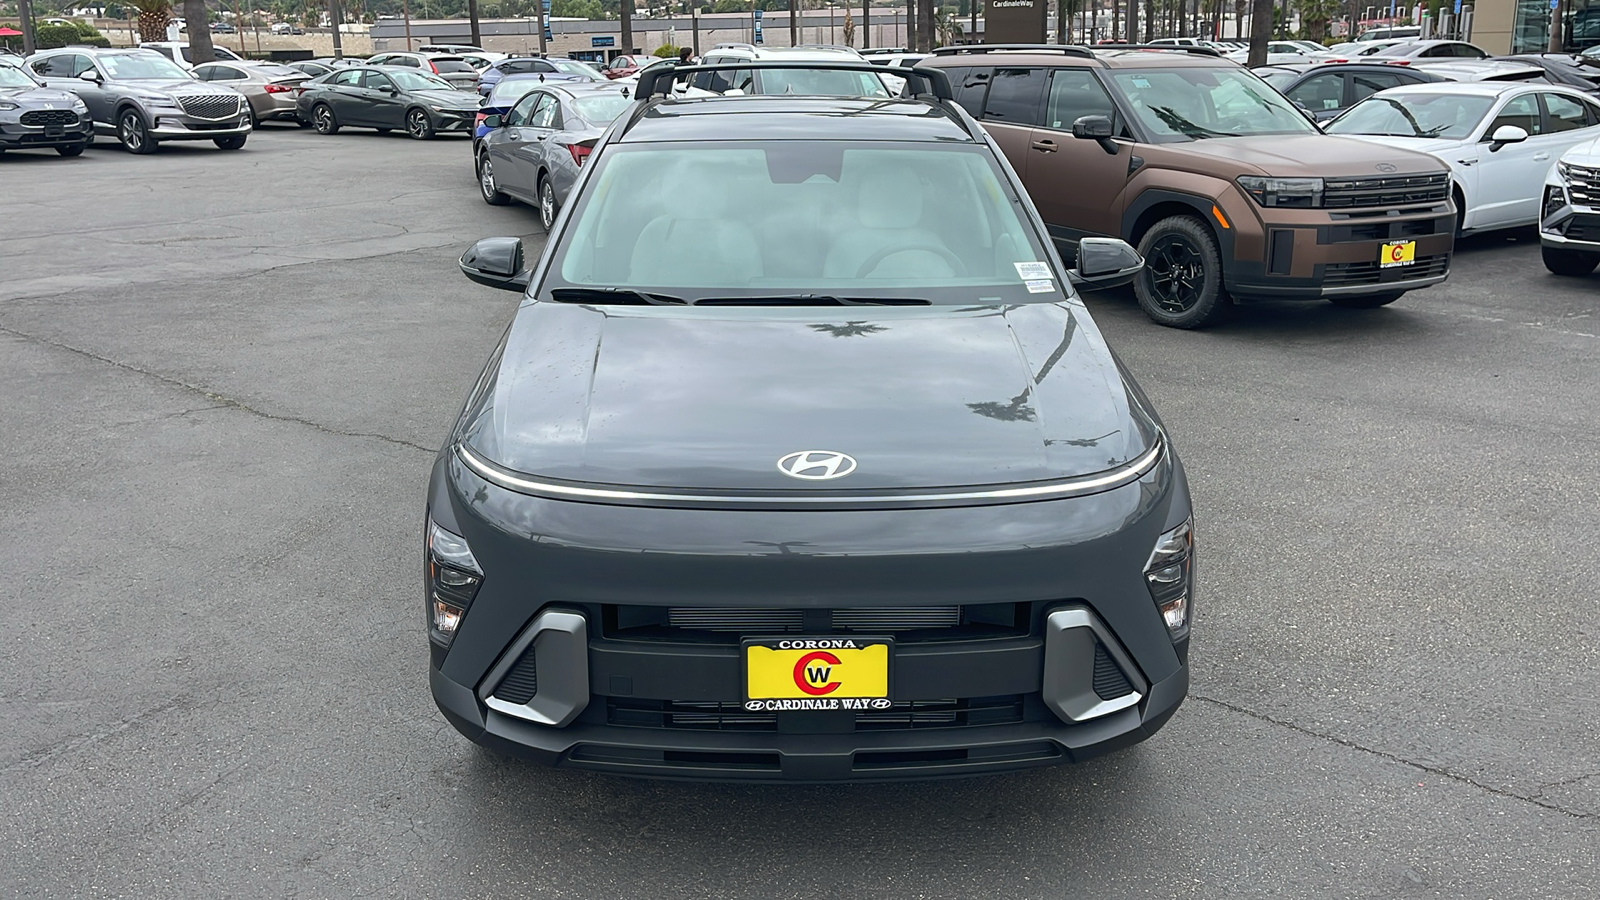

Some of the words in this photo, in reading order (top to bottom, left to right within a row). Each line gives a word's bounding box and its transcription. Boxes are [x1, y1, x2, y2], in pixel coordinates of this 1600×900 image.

[993, 0, 1034, 8] CardinaleWay
[778, 639, 856, 650] CORONA
[765, 699, 839, 711] CARDINALE
[842, 698, 871, 710] WAY
